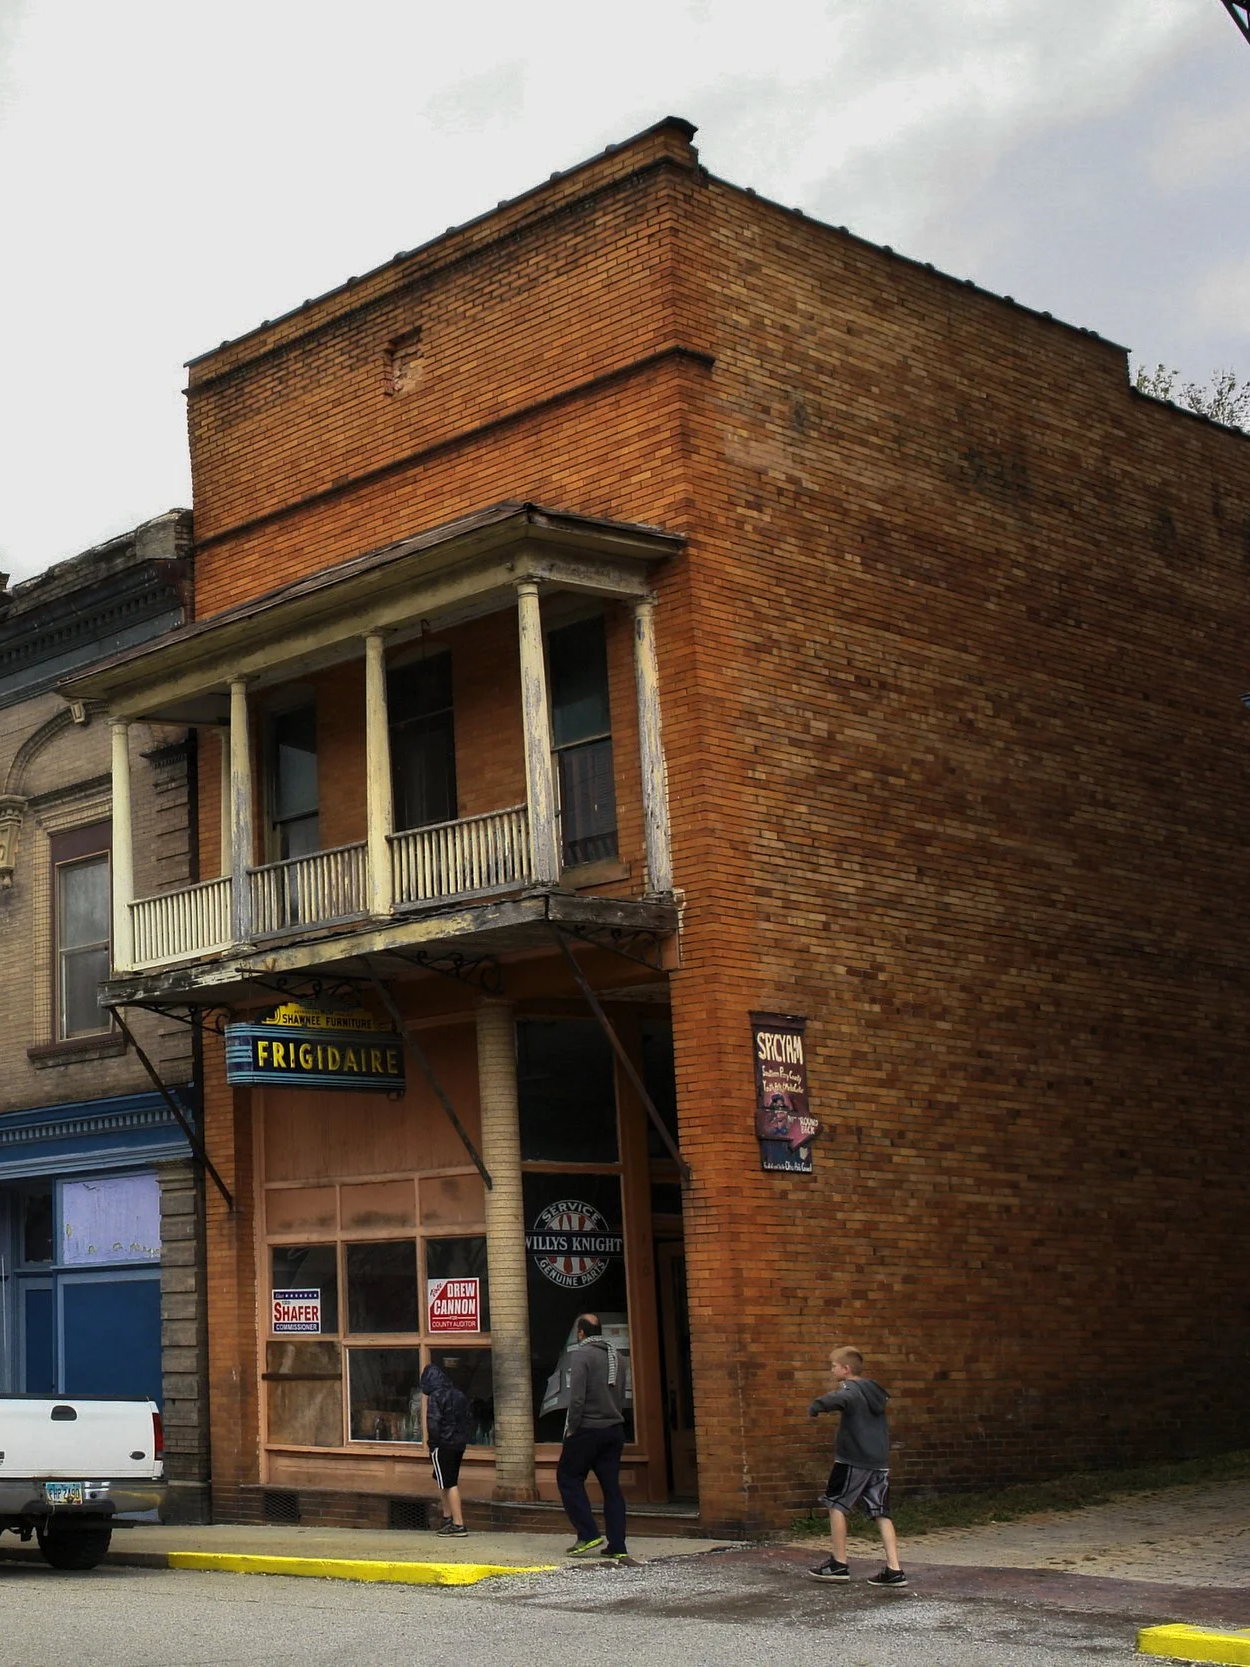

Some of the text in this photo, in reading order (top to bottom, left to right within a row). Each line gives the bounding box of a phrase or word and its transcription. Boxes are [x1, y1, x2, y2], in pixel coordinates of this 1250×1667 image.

[282, 1013, 373, 1029] SHAWNEE FURNITURE
[257, 1040, 399, 1074] FRIGIDAIRE
[542, 1202, 601, 1224] SERVICE
[572, 1237, 623, 1252] KNIGHT
[539, 1259, 605, 1286] GENUINE PARTS
[447, 1282, 476, 1298] DREW
[274, 1301, 319, 1322] SHAFER
[433, 1298, 476, 1315] CANNON
[275, 1323, 318, 1331] COMMISSIONER
[453, 1320, 477, 1328] AUDITOR
